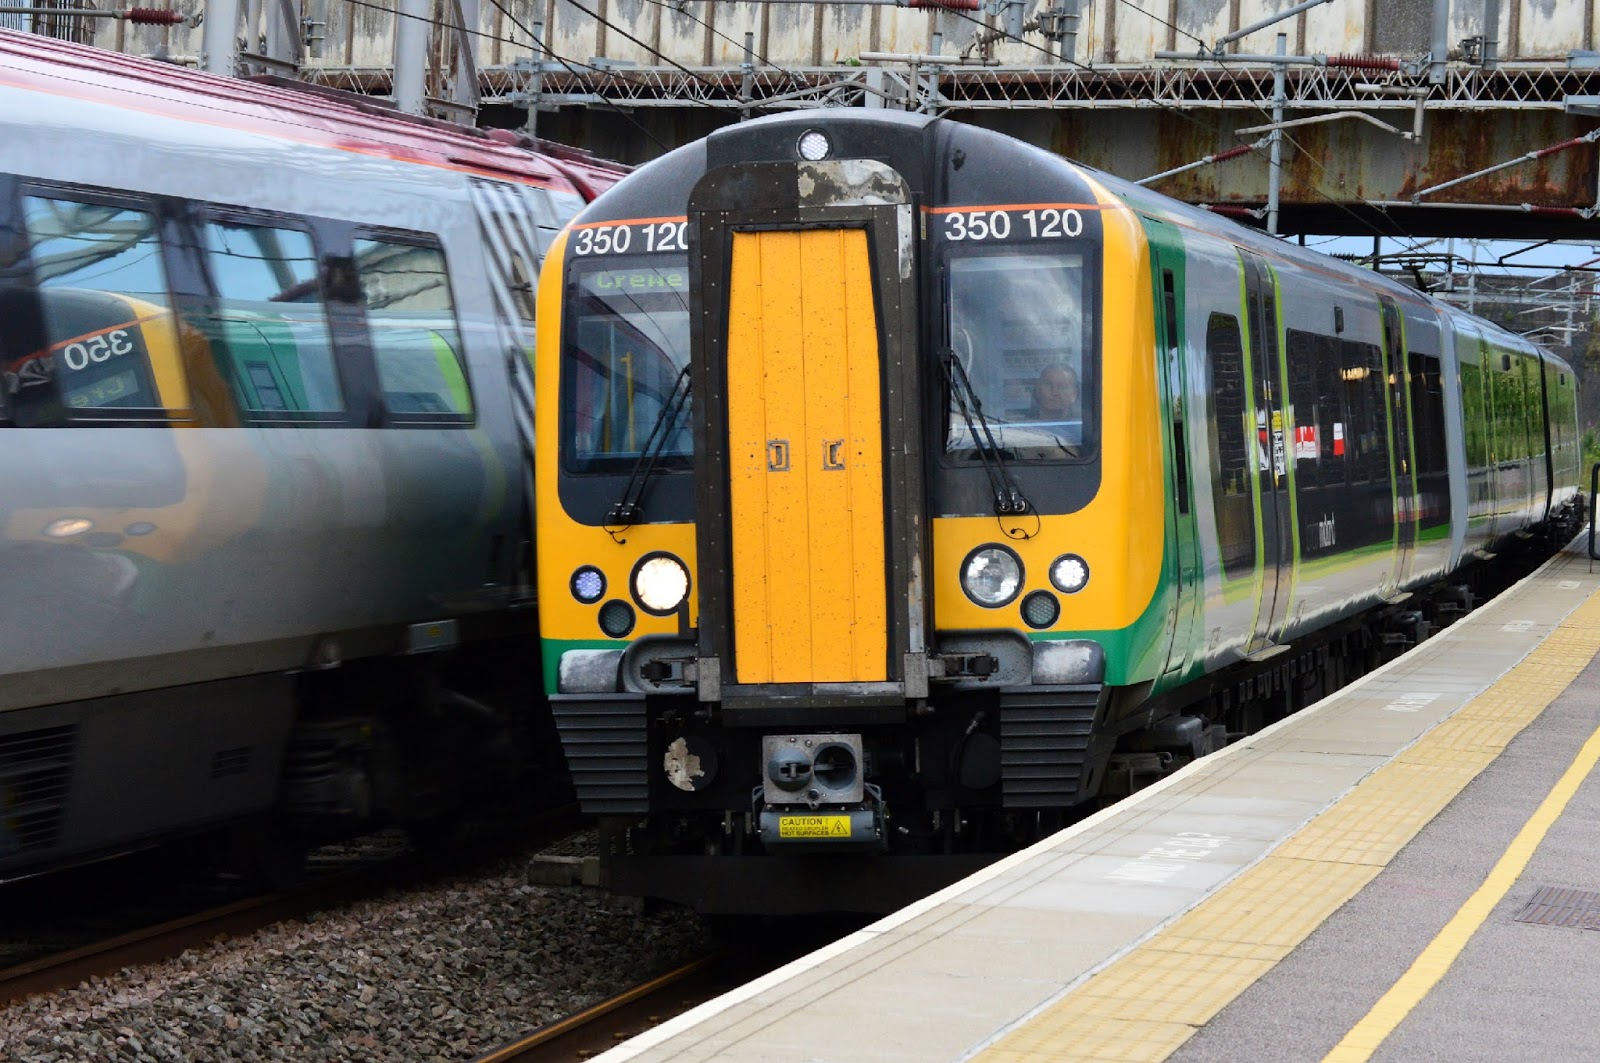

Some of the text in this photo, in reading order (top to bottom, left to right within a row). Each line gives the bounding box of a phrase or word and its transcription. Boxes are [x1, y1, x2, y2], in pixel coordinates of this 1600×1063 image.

[575, 225, 631, 255] 350
[944, 210, 1011, 241] 350
[1022, 209, 1083, 238] 120
[781, 818, 823, 826] CAUTION
